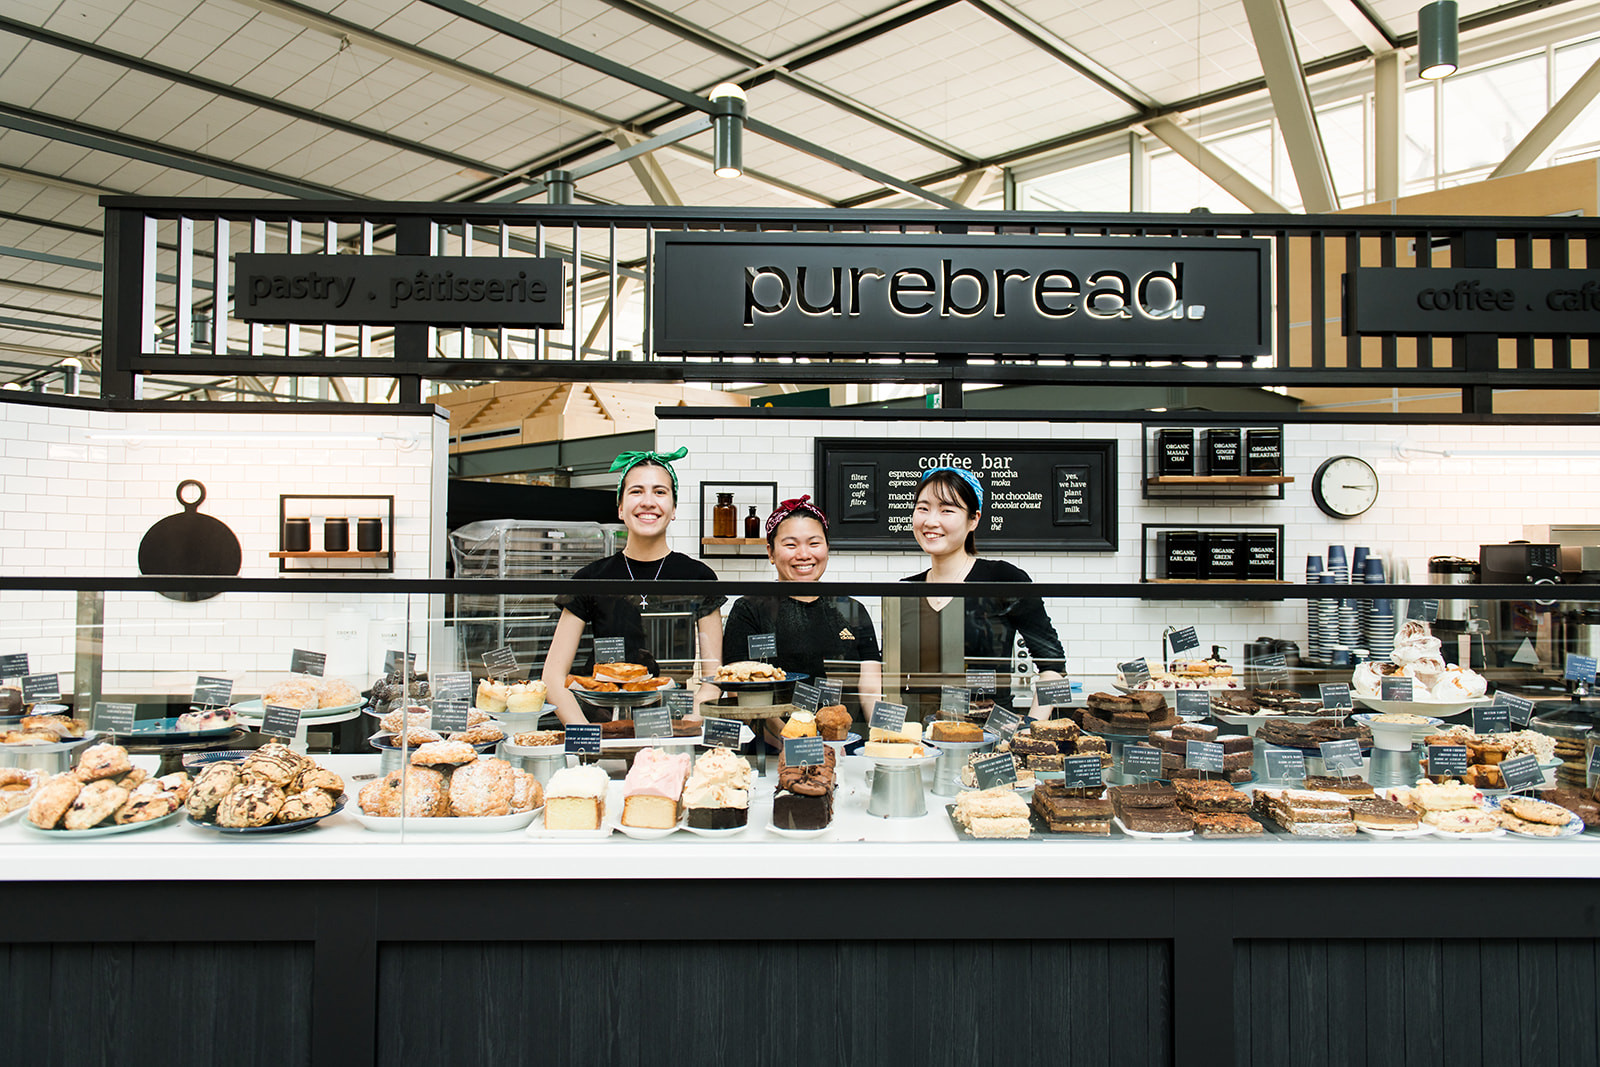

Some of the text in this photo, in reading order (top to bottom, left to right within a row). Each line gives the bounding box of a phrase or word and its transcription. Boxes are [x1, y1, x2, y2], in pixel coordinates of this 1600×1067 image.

[249, 271, 356, 314] pastry
[392, 272, 548, 314] pâtisserie
[744, 258, 1206, 327] purebread.
[1417, 279, 1516, 312] coffee
[919, 453, 1013, 470] coffee bar
[888, 470, 922, 479] espresso
[991, 471, 1018, 480] mocha
[1064, 473, 1078, 482] yes,
[888, 480, 917, 488] espresso
[1070, 481, 1087, 489] have
[991, 491, 1042, 501] hot chocolate
[1064, 489, 1081, 497] plant
[991, 516, 1003, 524] tea
